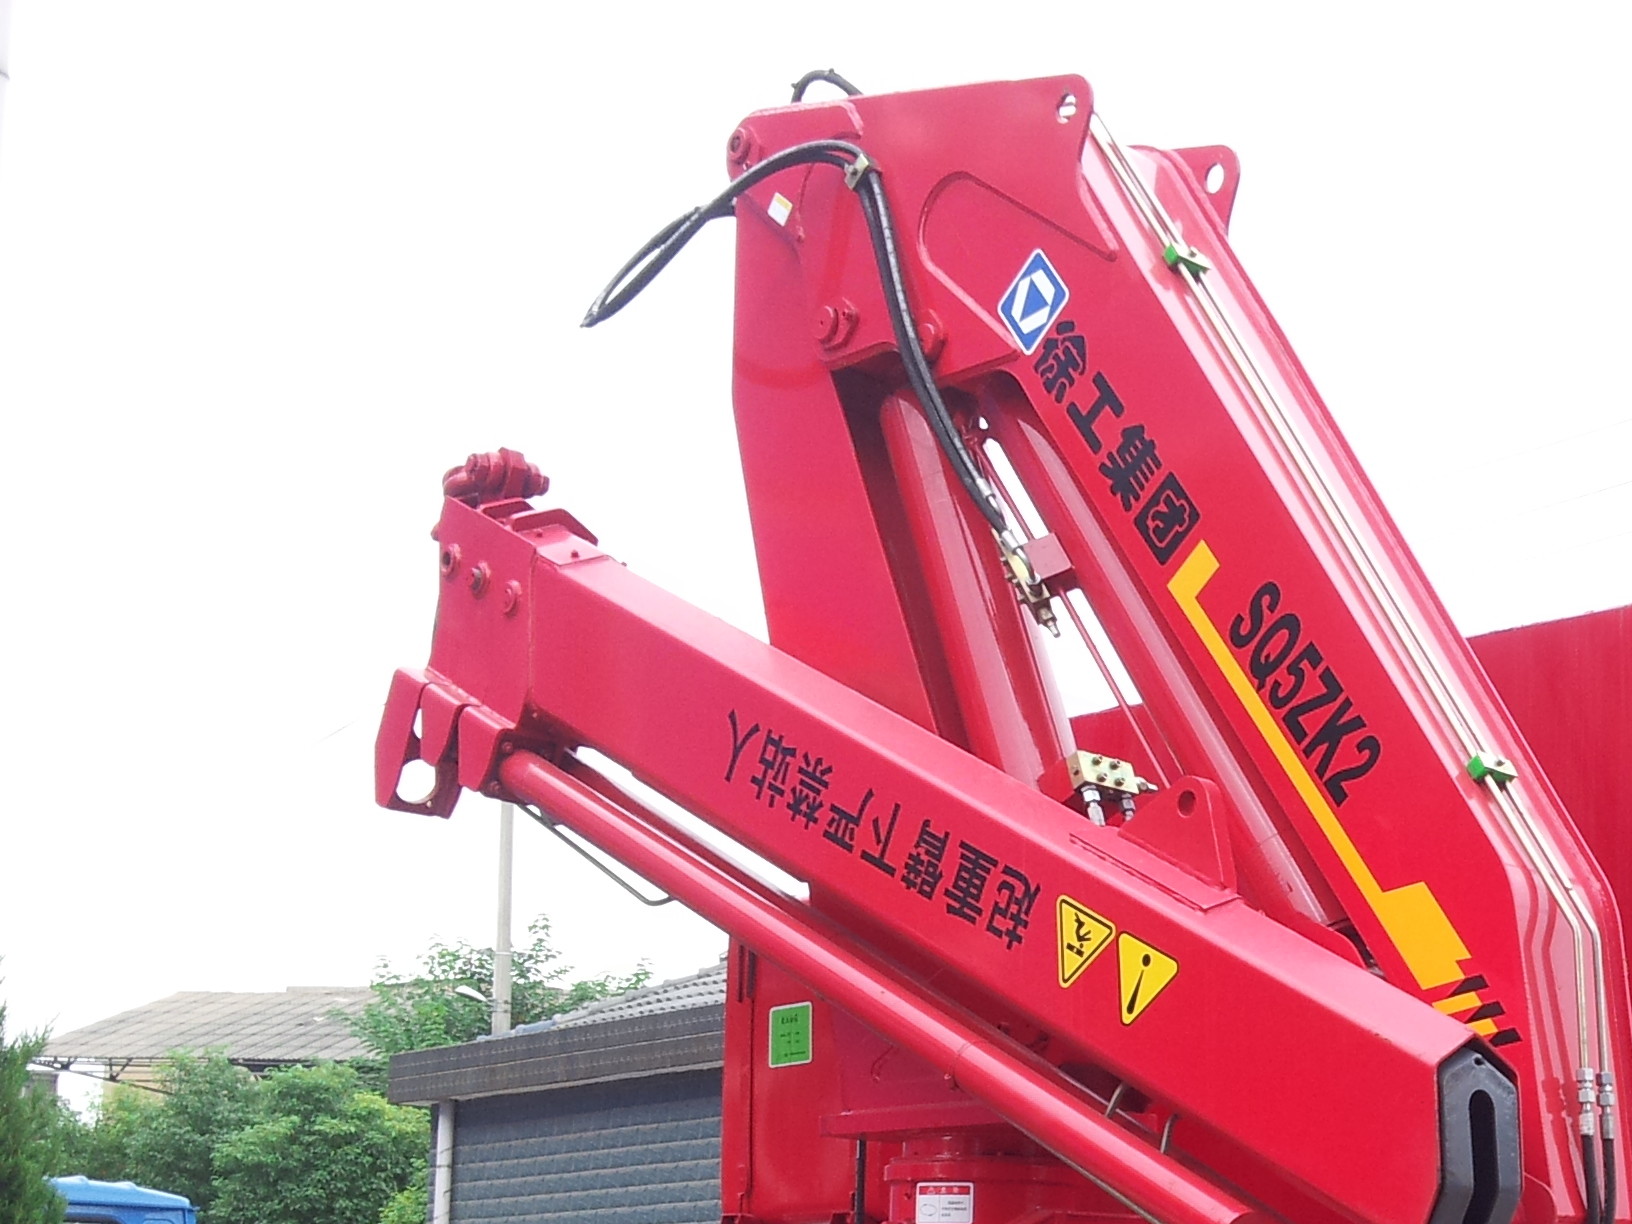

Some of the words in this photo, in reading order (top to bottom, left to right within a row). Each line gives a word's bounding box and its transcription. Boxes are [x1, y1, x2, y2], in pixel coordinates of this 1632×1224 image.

[1032, 321, 1201, 566] 徐工集团
[1229, 581, 1382, 806] SQ5ZK2
[725, 709, 1042, 950] 起重臂下严禁站人
